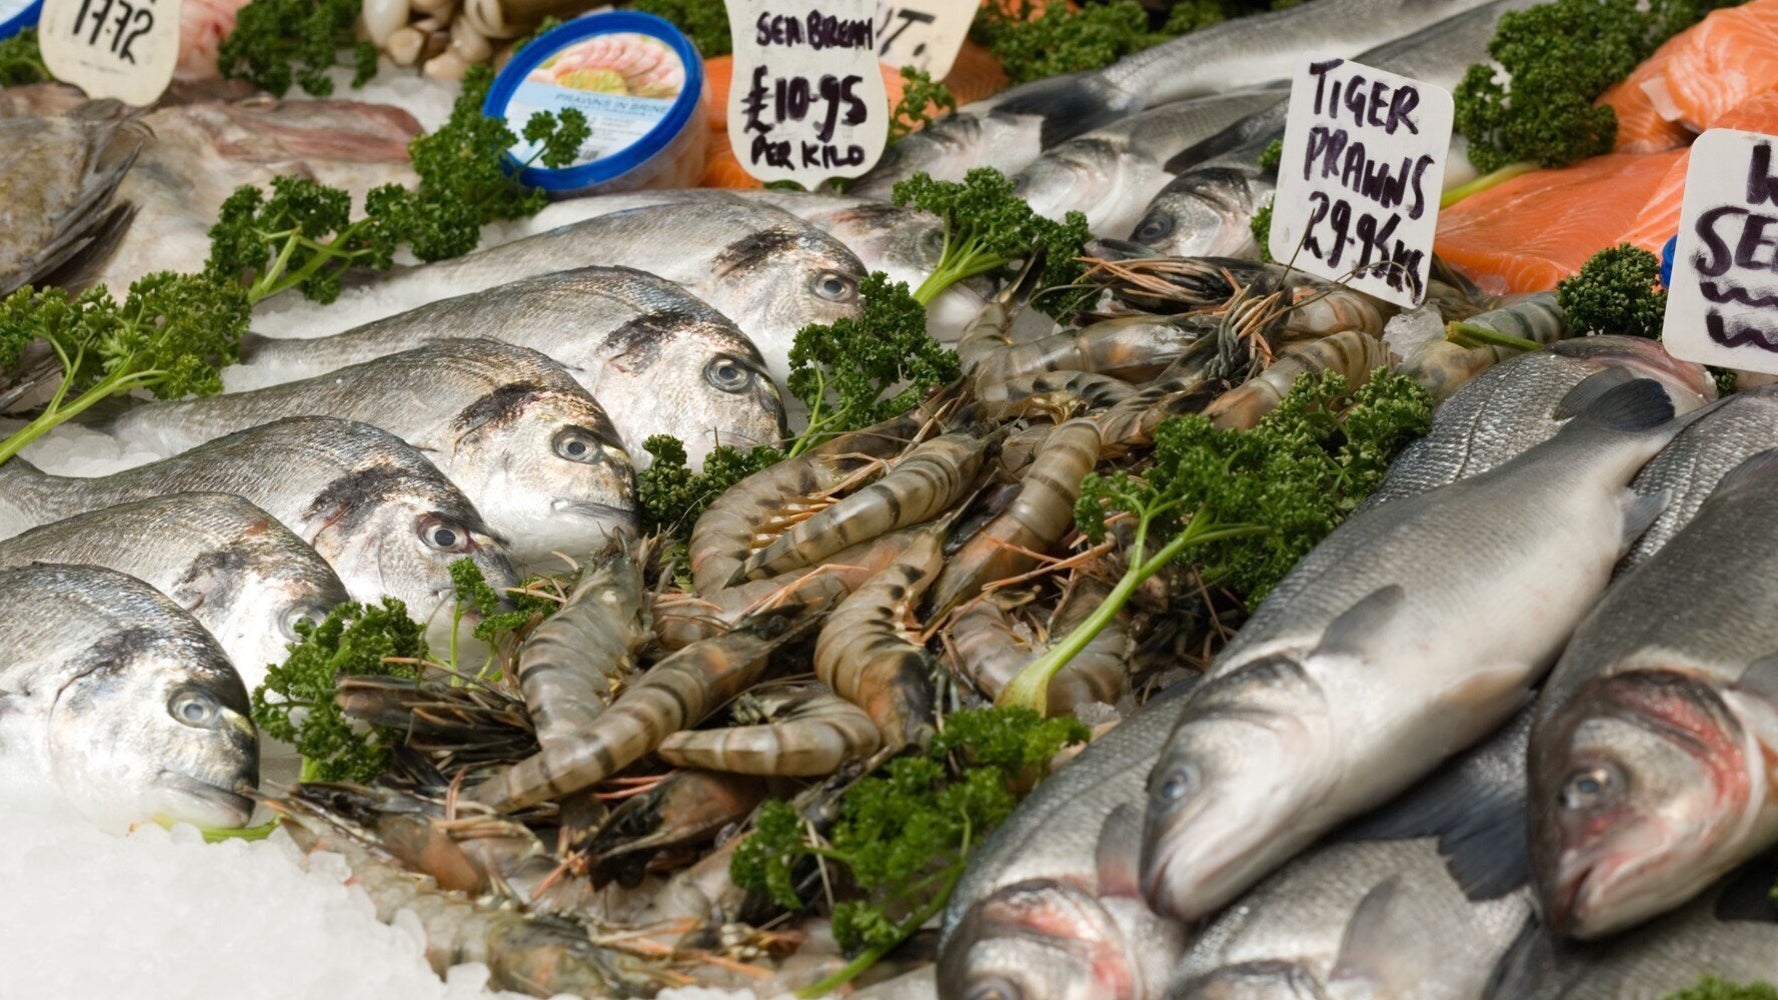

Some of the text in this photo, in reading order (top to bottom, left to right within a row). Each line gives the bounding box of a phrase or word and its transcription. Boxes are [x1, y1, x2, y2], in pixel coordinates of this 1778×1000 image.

[756, 11, 805, 47] SEA
[741, 65, 867, 143] £10.95
[1309, 58, 1420, 135] TIGER
[751, 135, 865, 170] PER KILO
[1303, 126, 1435, 220] PRAWNS
[1691, 205, 1778, 277] SE
